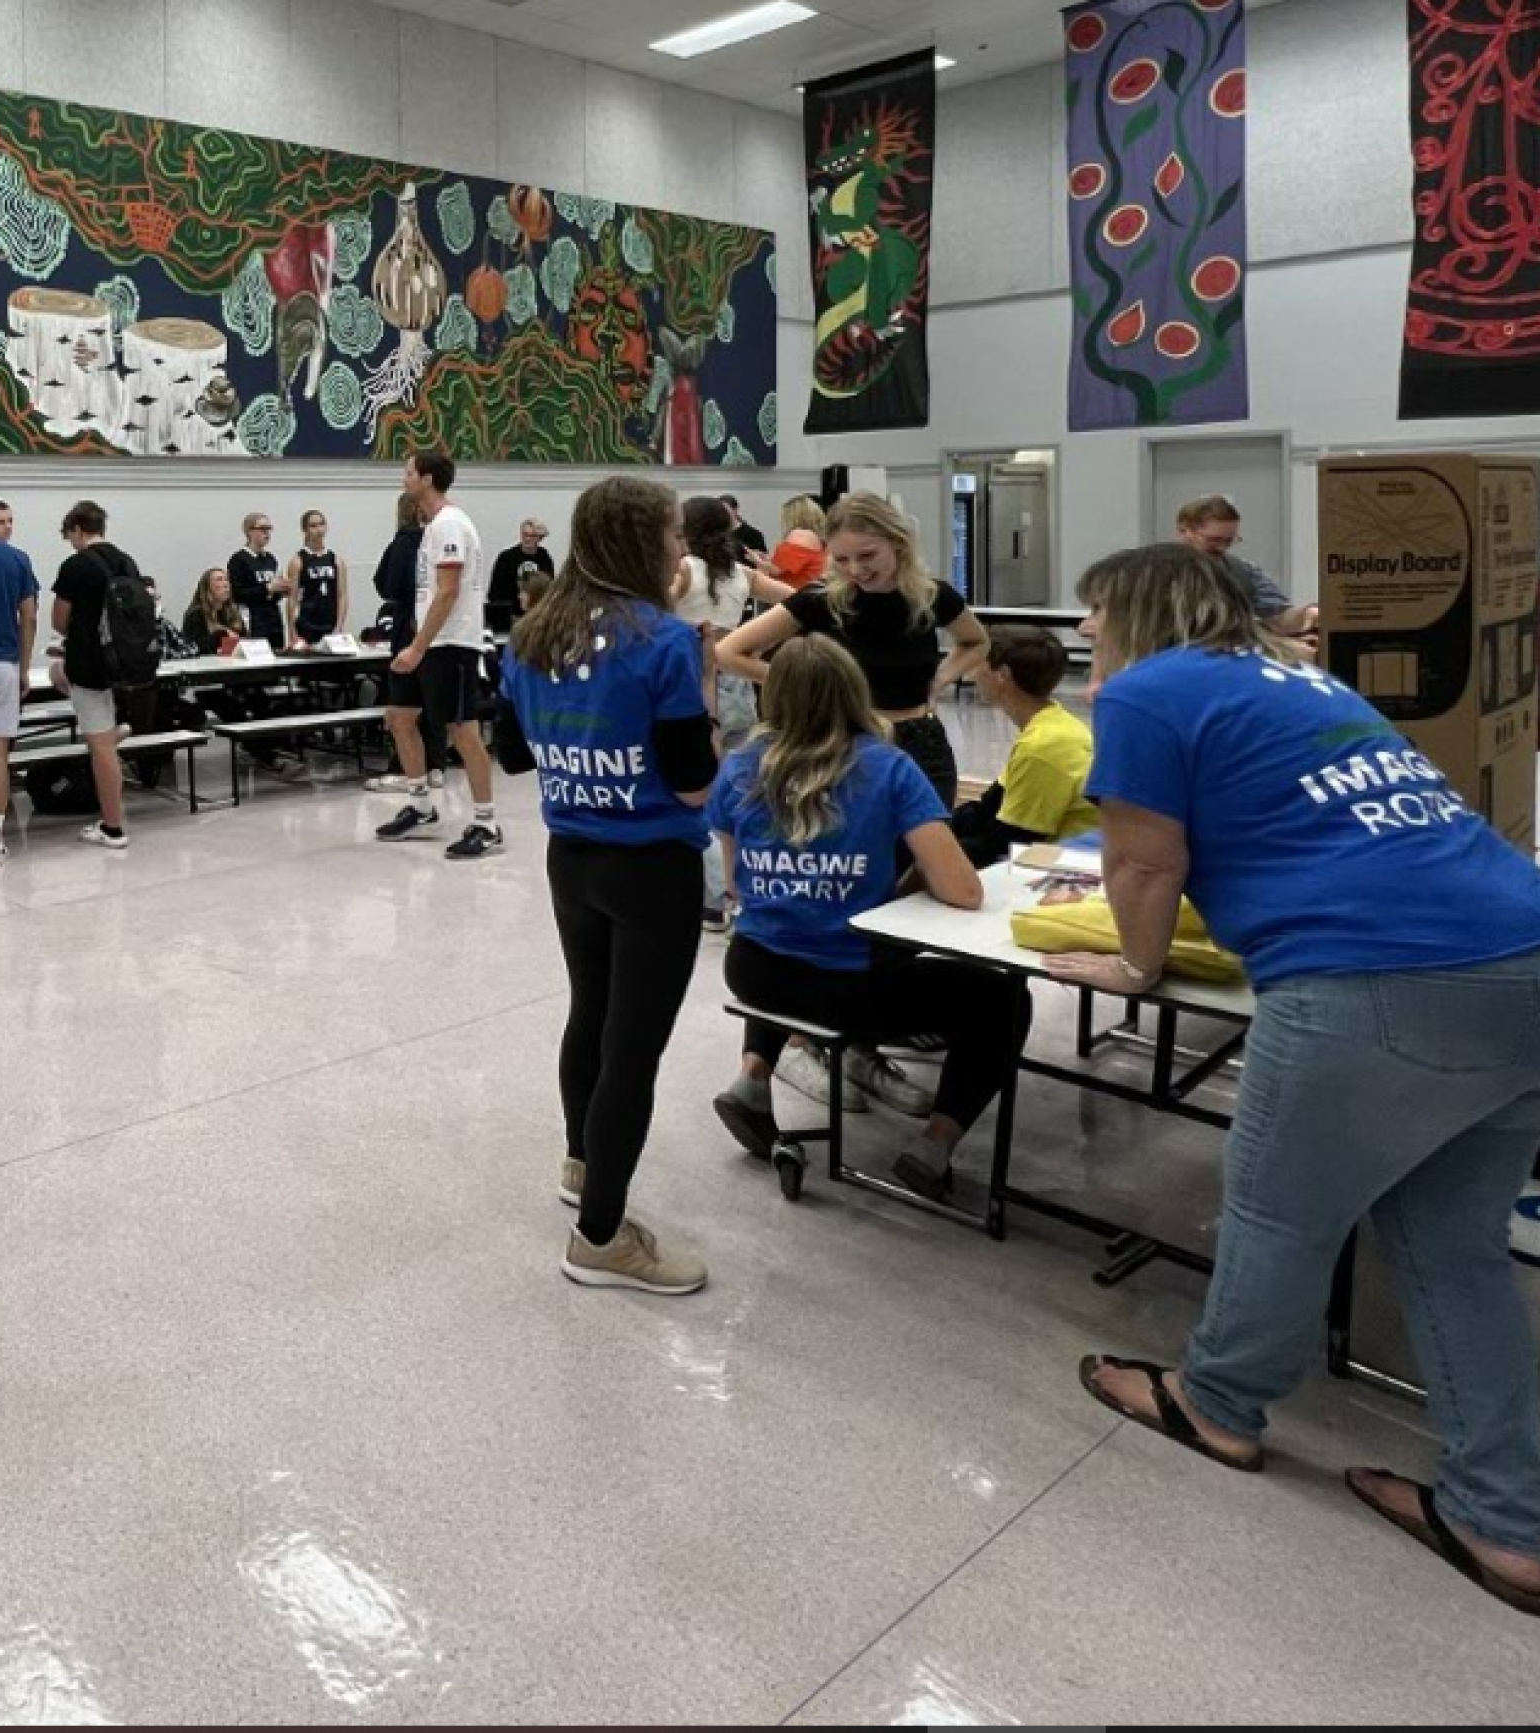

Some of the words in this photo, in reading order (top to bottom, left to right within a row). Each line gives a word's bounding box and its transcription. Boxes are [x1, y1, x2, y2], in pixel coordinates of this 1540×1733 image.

[1327, 552, 1400, 578] Display
[1401, 551, 1460, 572] Board
[527, 740, 646, 777] MAGINE
[1298, 750, 1445, 804] IMAG
[741, 847, 868, 876] IMAGINE
